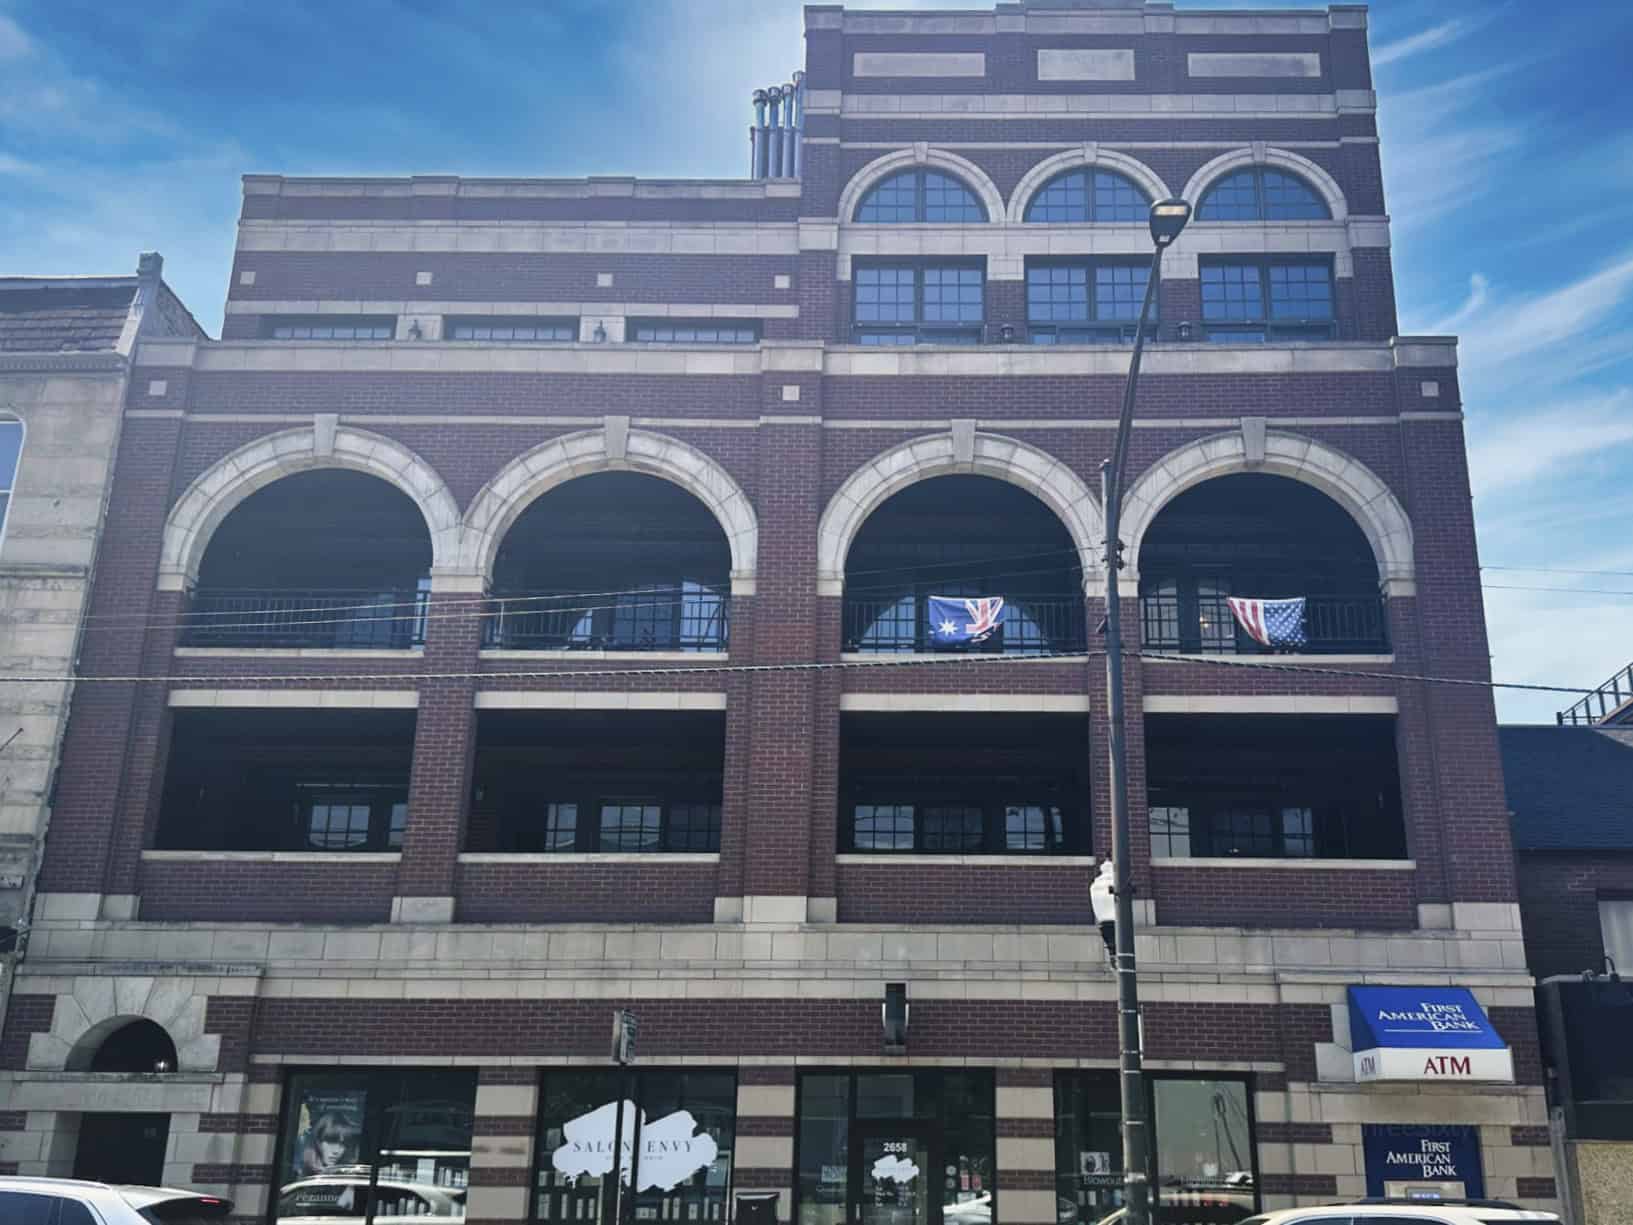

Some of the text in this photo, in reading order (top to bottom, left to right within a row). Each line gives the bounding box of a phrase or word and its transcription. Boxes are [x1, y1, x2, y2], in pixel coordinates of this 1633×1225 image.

[1420, 1002, 1463, 1013] FIRST
[1378, 1010, 1467, 1020] AMERICAN
[1431, 1020, 1480, 1031] BANK
[1360, 1055, 1376, 1073] ATM
[1423, 1055, 1471, 1075] ATM
[647, 1140, 691, 1153] ENVY
[883, 1141, 907, 1152] 2658
[1421, 1139, 1451, 1152] FIRST
[1386, 1151, 1451, 1164] AMERICAN
[1423, 1165, 1457, 1178] BANK
